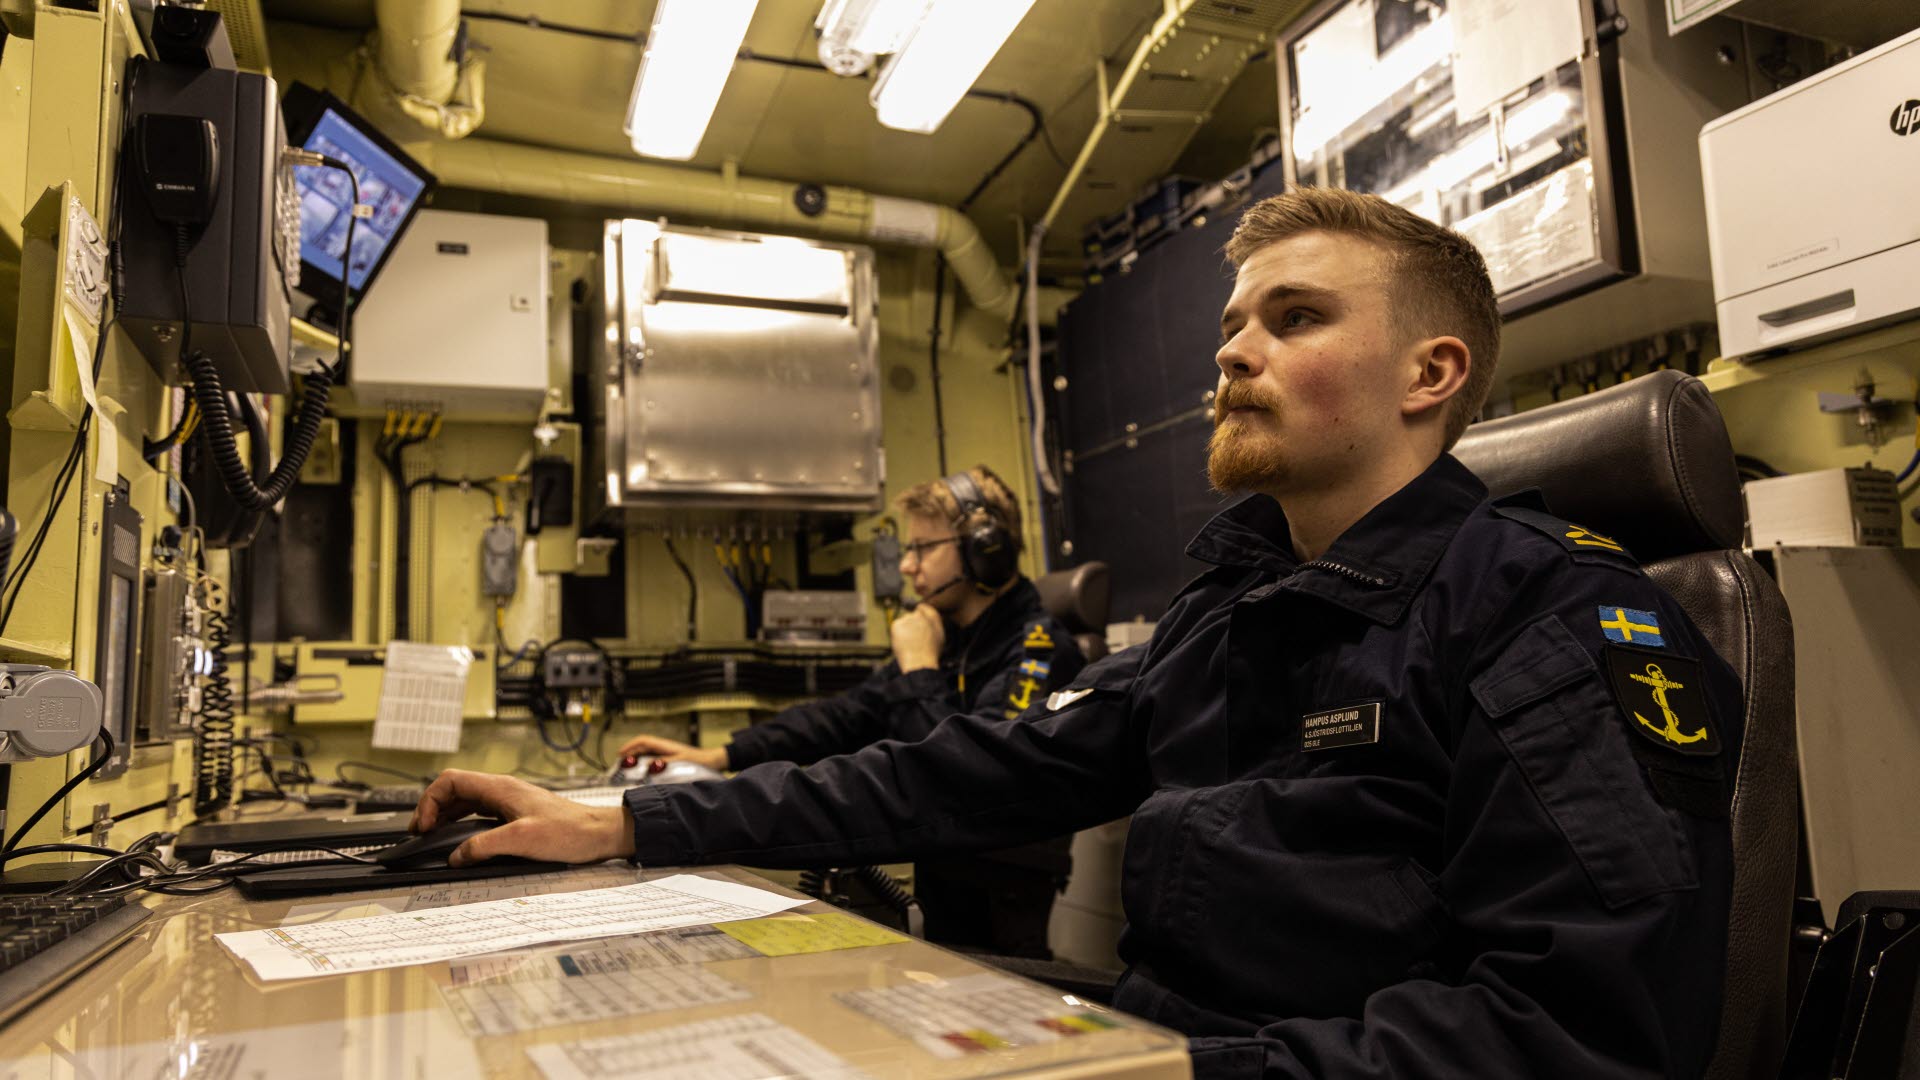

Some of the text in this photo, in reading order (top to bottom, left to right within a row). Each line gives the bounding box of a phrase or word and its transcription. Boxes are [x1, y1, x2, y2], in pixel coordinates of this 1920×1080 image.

[1894, 100, 1920, 136] hp
[1305, 711, 1359, 728] HAMPUS ASPLUND
